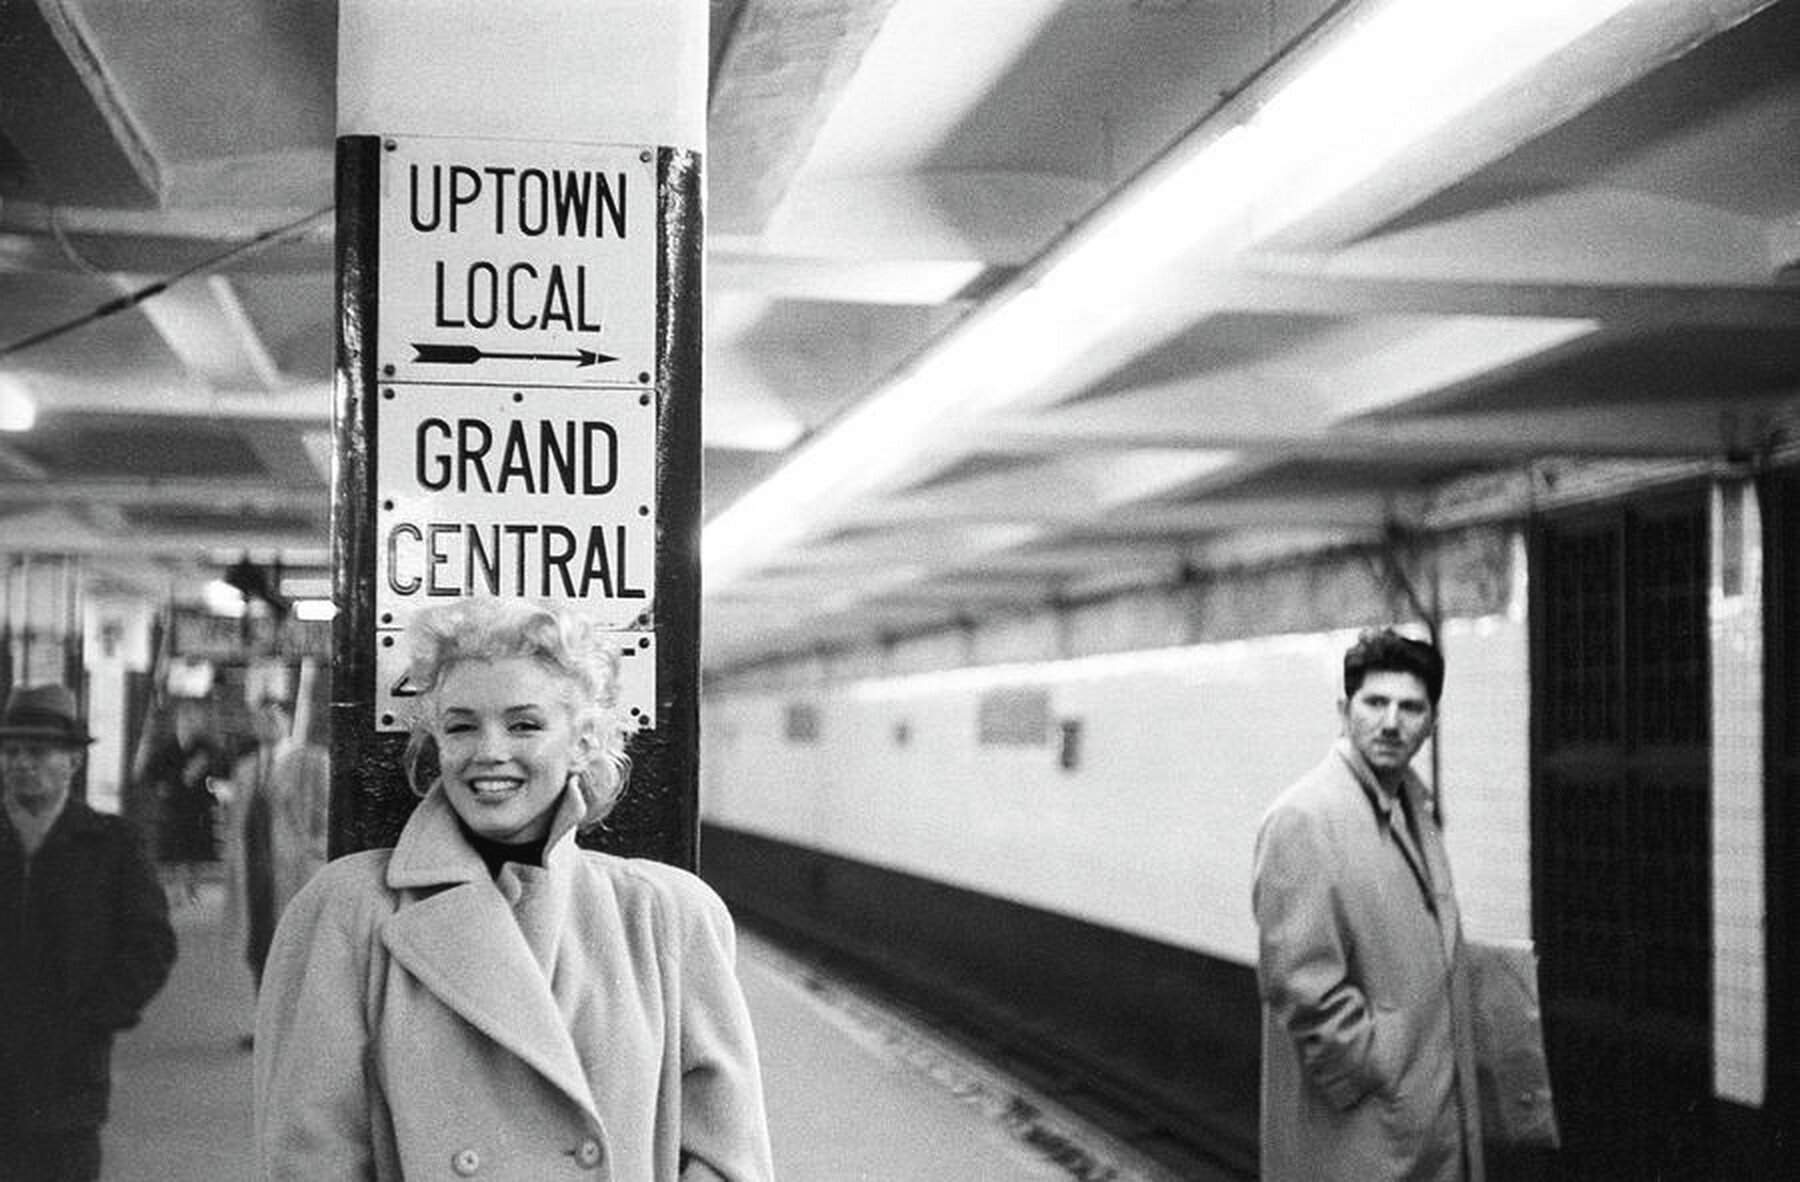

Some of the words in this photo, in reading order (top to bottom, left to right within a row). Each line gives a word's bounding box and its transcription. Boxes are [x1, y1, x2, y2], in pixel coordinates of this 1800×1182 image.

[410, 164, 626, 239] UPTOWN
[435, 261, 601, 332] LOCAL
[416, 417, 618, 495] GRAND
[387, 523, 646, 599] CENTRAL
